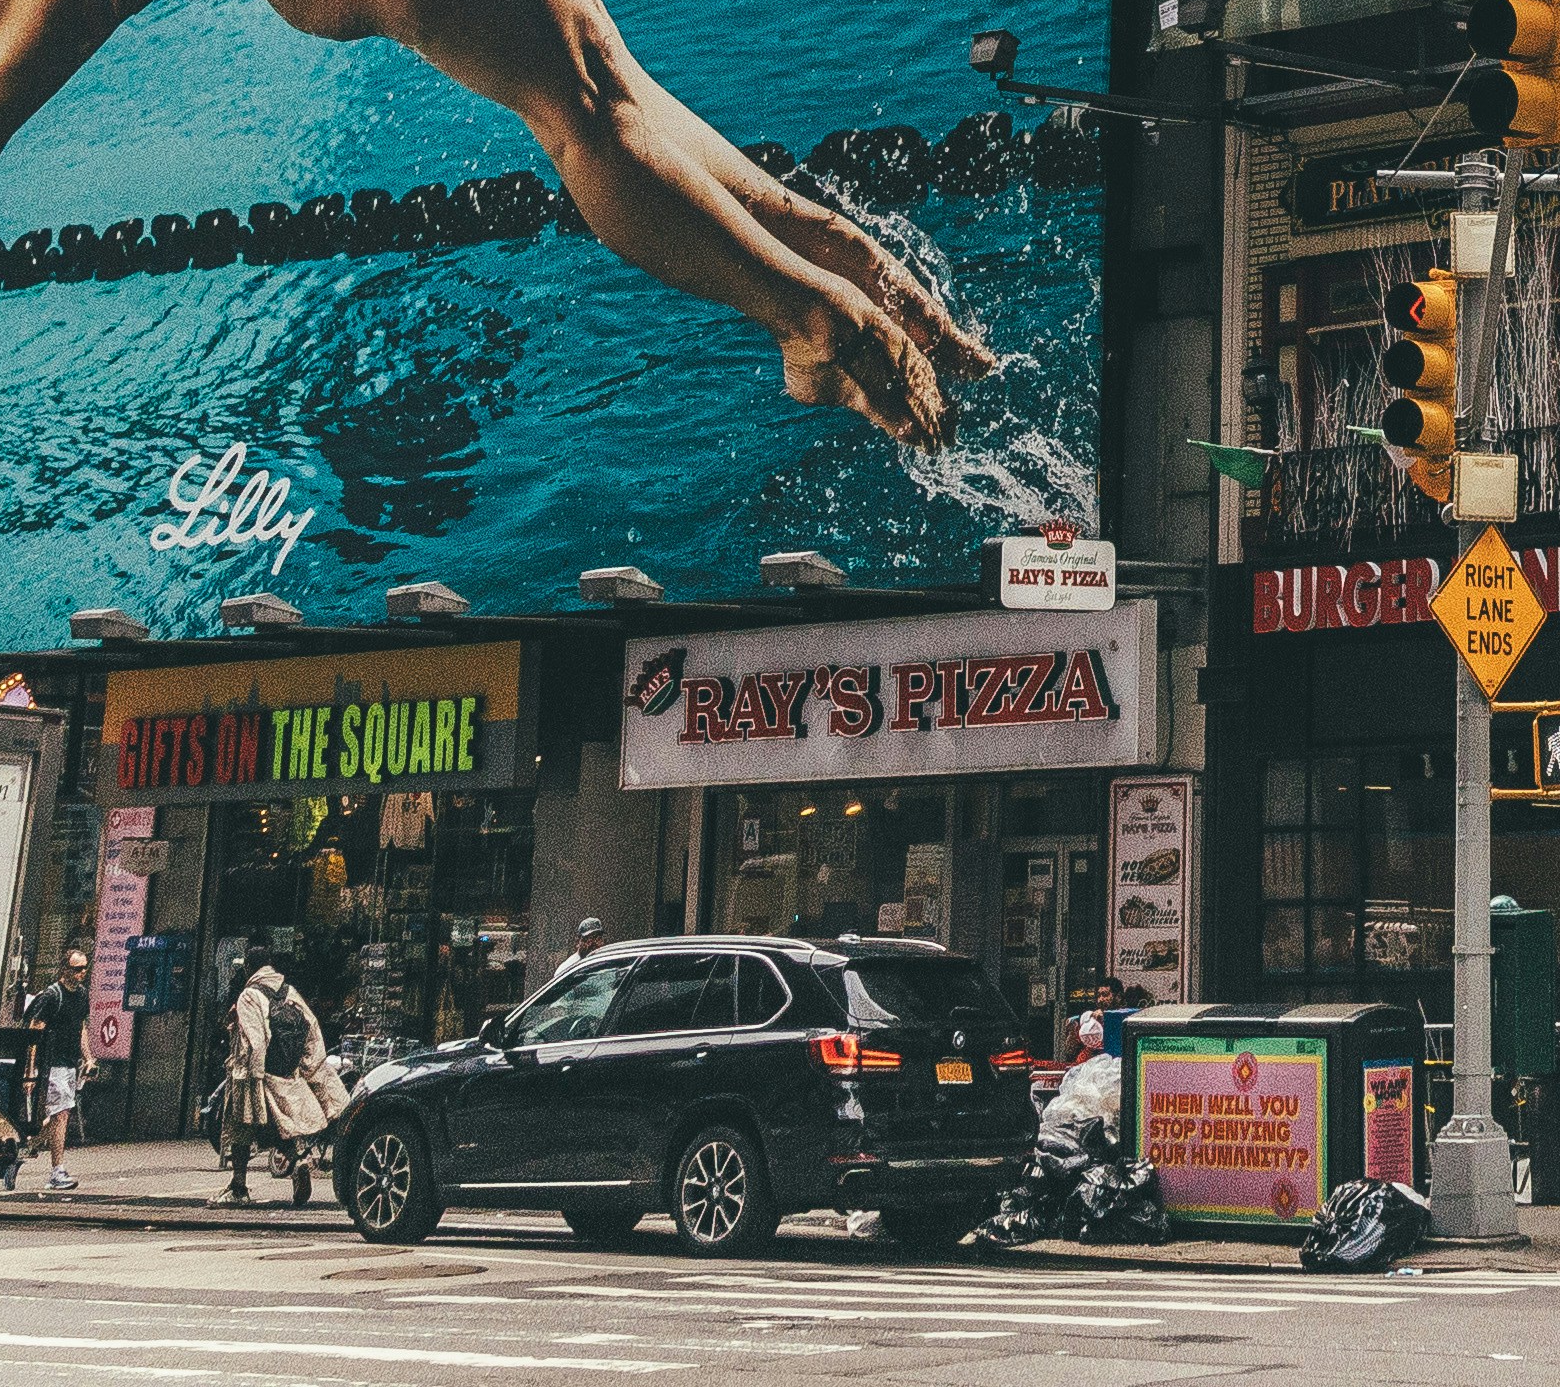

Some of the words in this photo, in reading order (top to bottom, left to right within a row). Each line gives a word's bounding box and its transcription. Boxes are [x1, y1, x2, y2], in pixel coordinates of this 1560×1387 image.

[150, 441, 315, 575] Lilly
[1047, 530, 1074, 542] RAY'S
[1021, 549, 1058, 567] Famous
[1060, 551, 1098, 569] Original
[1008, 568, 1055, 586] RAY'S
[1061, 570, 1109, 587] PIZZA
[1464, 563, 1516, 591] RIGHT
[1254, 560, 1443, 634] BURGER
[1466, 597, 1516, 624] LANE
[1467, 630, 1514, 658] ENDS
[640, 665, 670, 704] RAY'S
[678, 664, 874, 745] RAY'S
[889, 650, 1110, 733] PIZZA
[117, 712, 207, 789] GIFTS
[214, 712, 261, 785] ON
[271, 710, 328, 784] THE
[336, 694, 475, 781] SQUARE
[101, 1018, 117, 1044] 16
[1149, 1092, 1203, 1118] WHEN
[1207, 1093, 1254, 1118] WILL
[1259, 1094, 1300, 1118] YOU
[1149, 1118, 1197, 1142] STOP
[1200, 1120, 1291, 1145] DENYING
[1149, 1144, 1188, 1169] OUR
[1190, 1145, 1310, 1171] HUMANITY?
